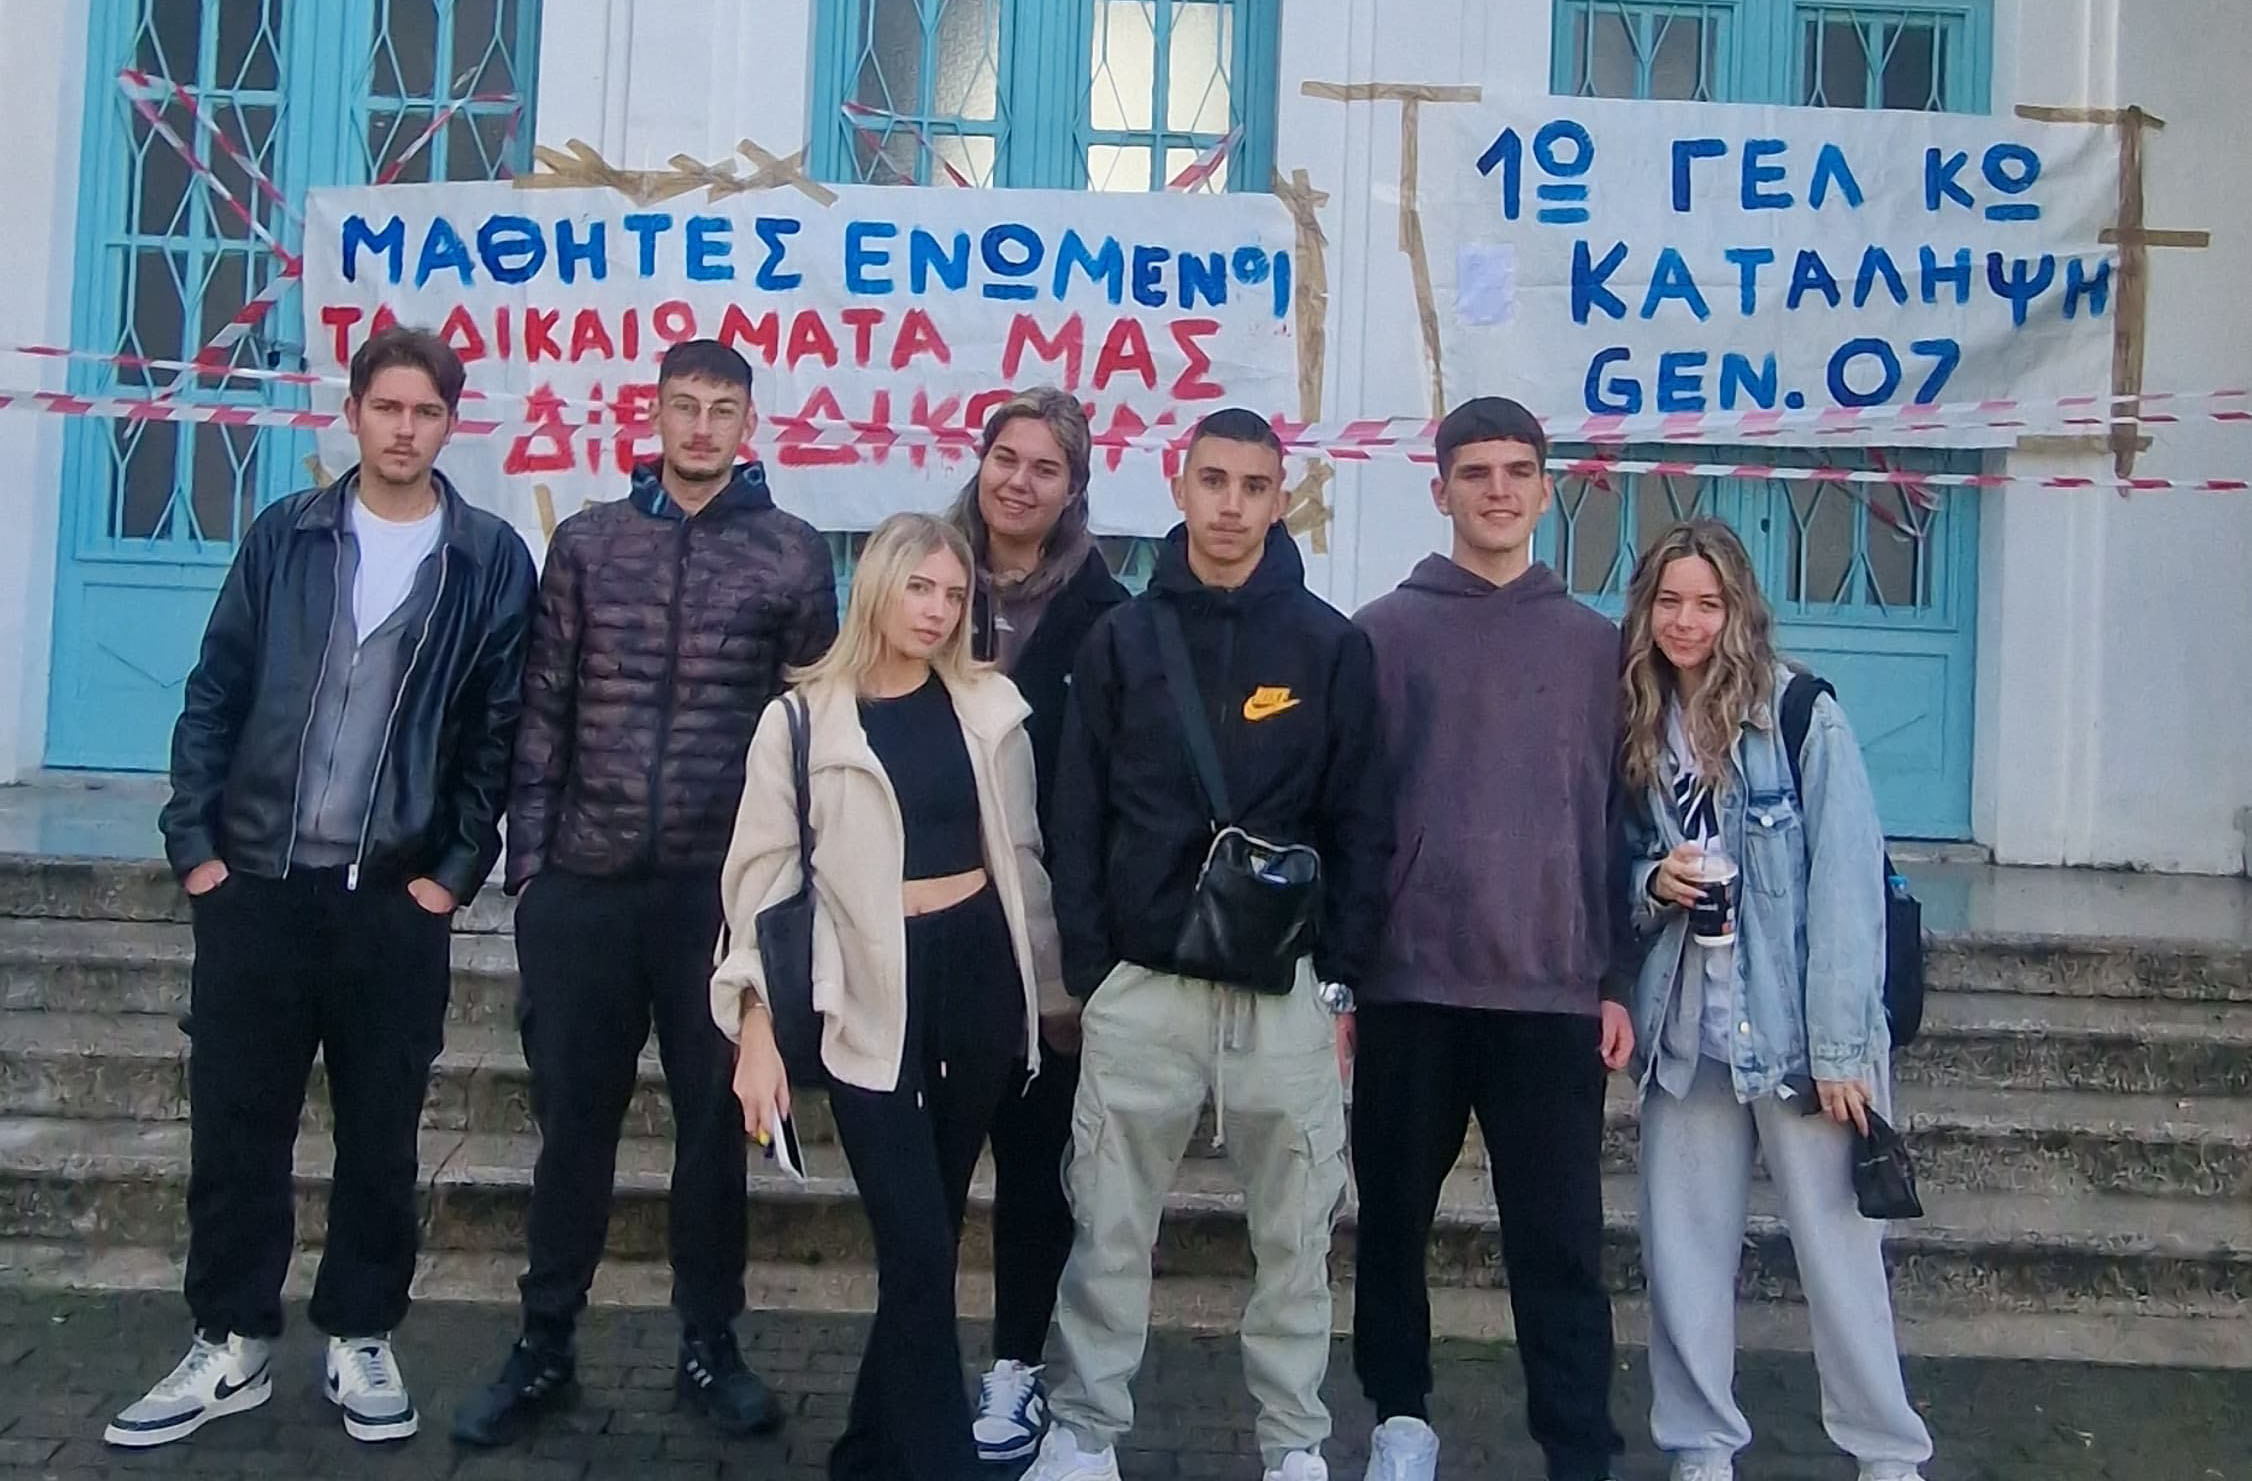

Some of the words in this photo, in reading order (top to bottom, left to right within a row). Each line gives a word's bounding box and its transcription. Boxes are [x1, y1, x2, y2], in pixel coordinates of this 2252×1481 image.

[1671, 138, 1865, 213] ΓΕΛ
[341, 213, 802, 292] ΜΑΘΗΤΕΣ
[844, 220, 1292, 319] ΕΝΩΜΕΝΟΙ
[1570, 239, 2112, 328] ΚΑΤΑΛΗΨΗ
[1001, 310, 1226, 401] ΜΑΣ
